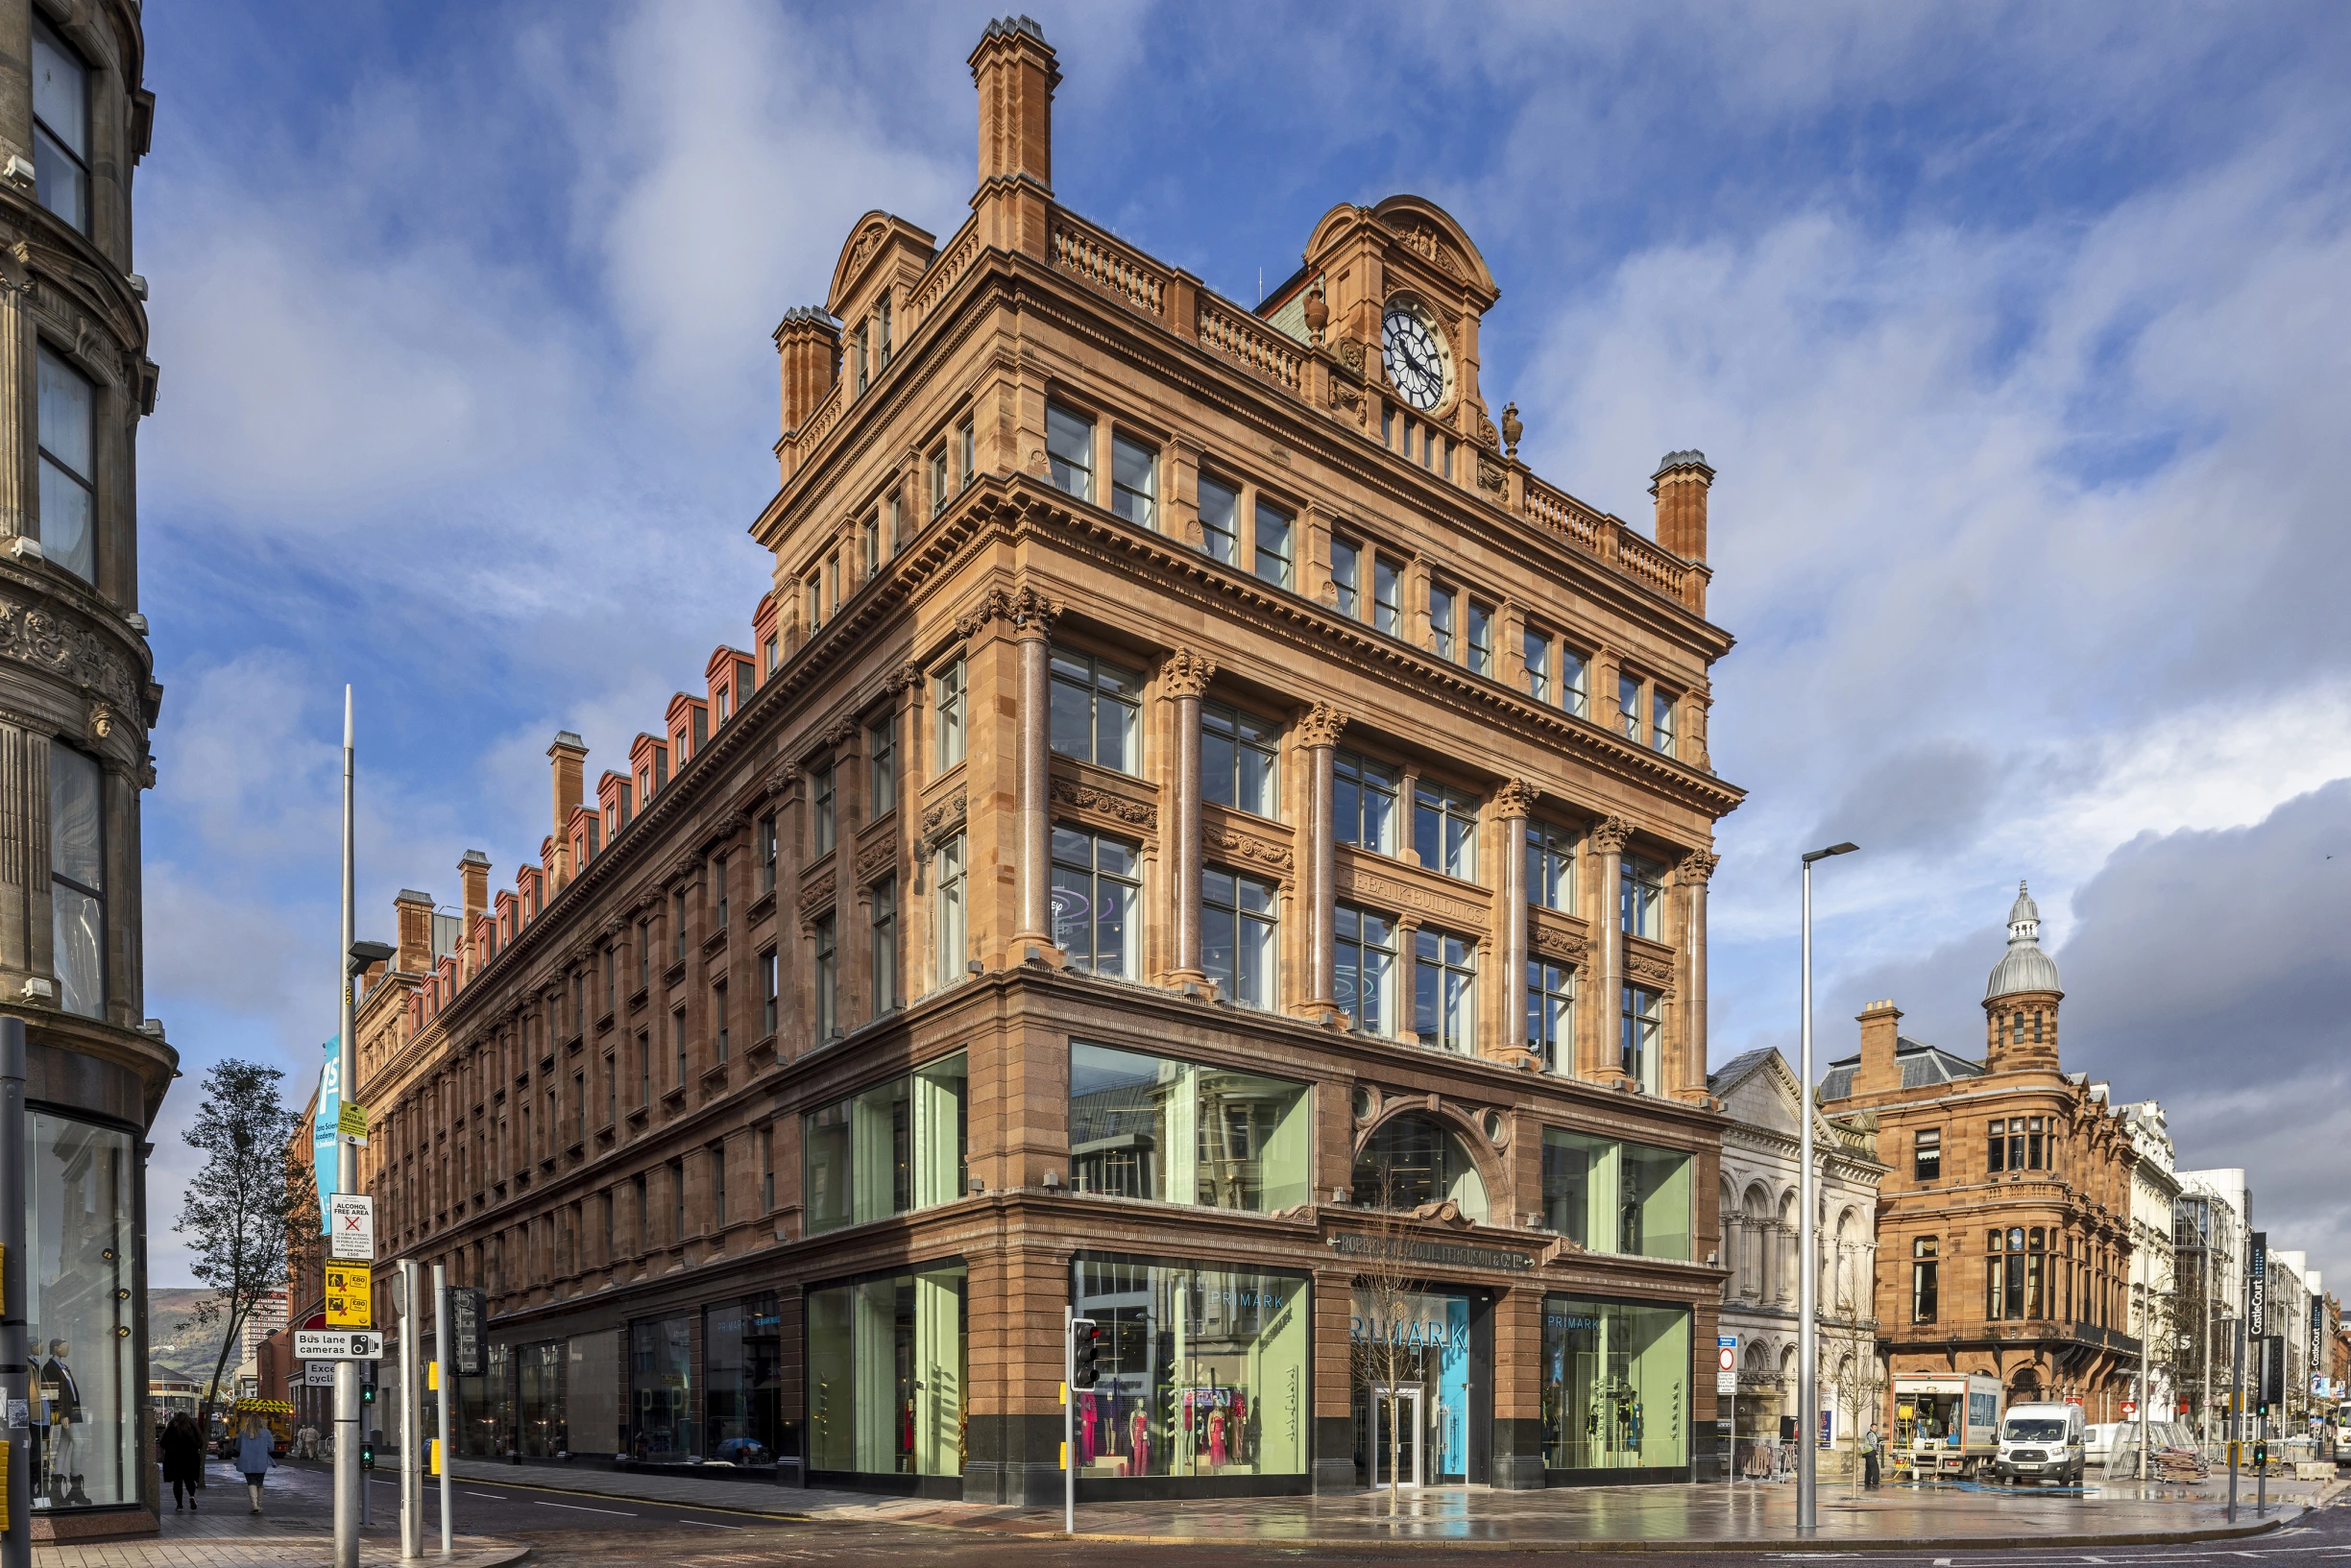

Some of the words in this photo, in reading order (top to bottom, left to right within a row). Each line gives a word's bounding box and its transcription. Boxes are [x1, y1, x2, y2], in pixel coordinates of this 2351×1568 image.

[325, 1122, 338, 1130] Scien
[1442, 1247, 1491, 1266] FERGUSON
[1493, 1255, 1499, 1266] &
[1211, 1291, 1283, 1309] PRIMARK
[2251, 1279, 2263, 1334] CastleCourt
[1547, 1316, 1599, 1330] PRIMARK
[299, 1335, 319, 1343] Bus
[323, 1335, 345, 1344] lane
[1350, 1317, 1466, 1350] RIMARK
[2311, 1327, 2320, 1366] CastleCourt
[309, 1375, 334, 1383] cycli
